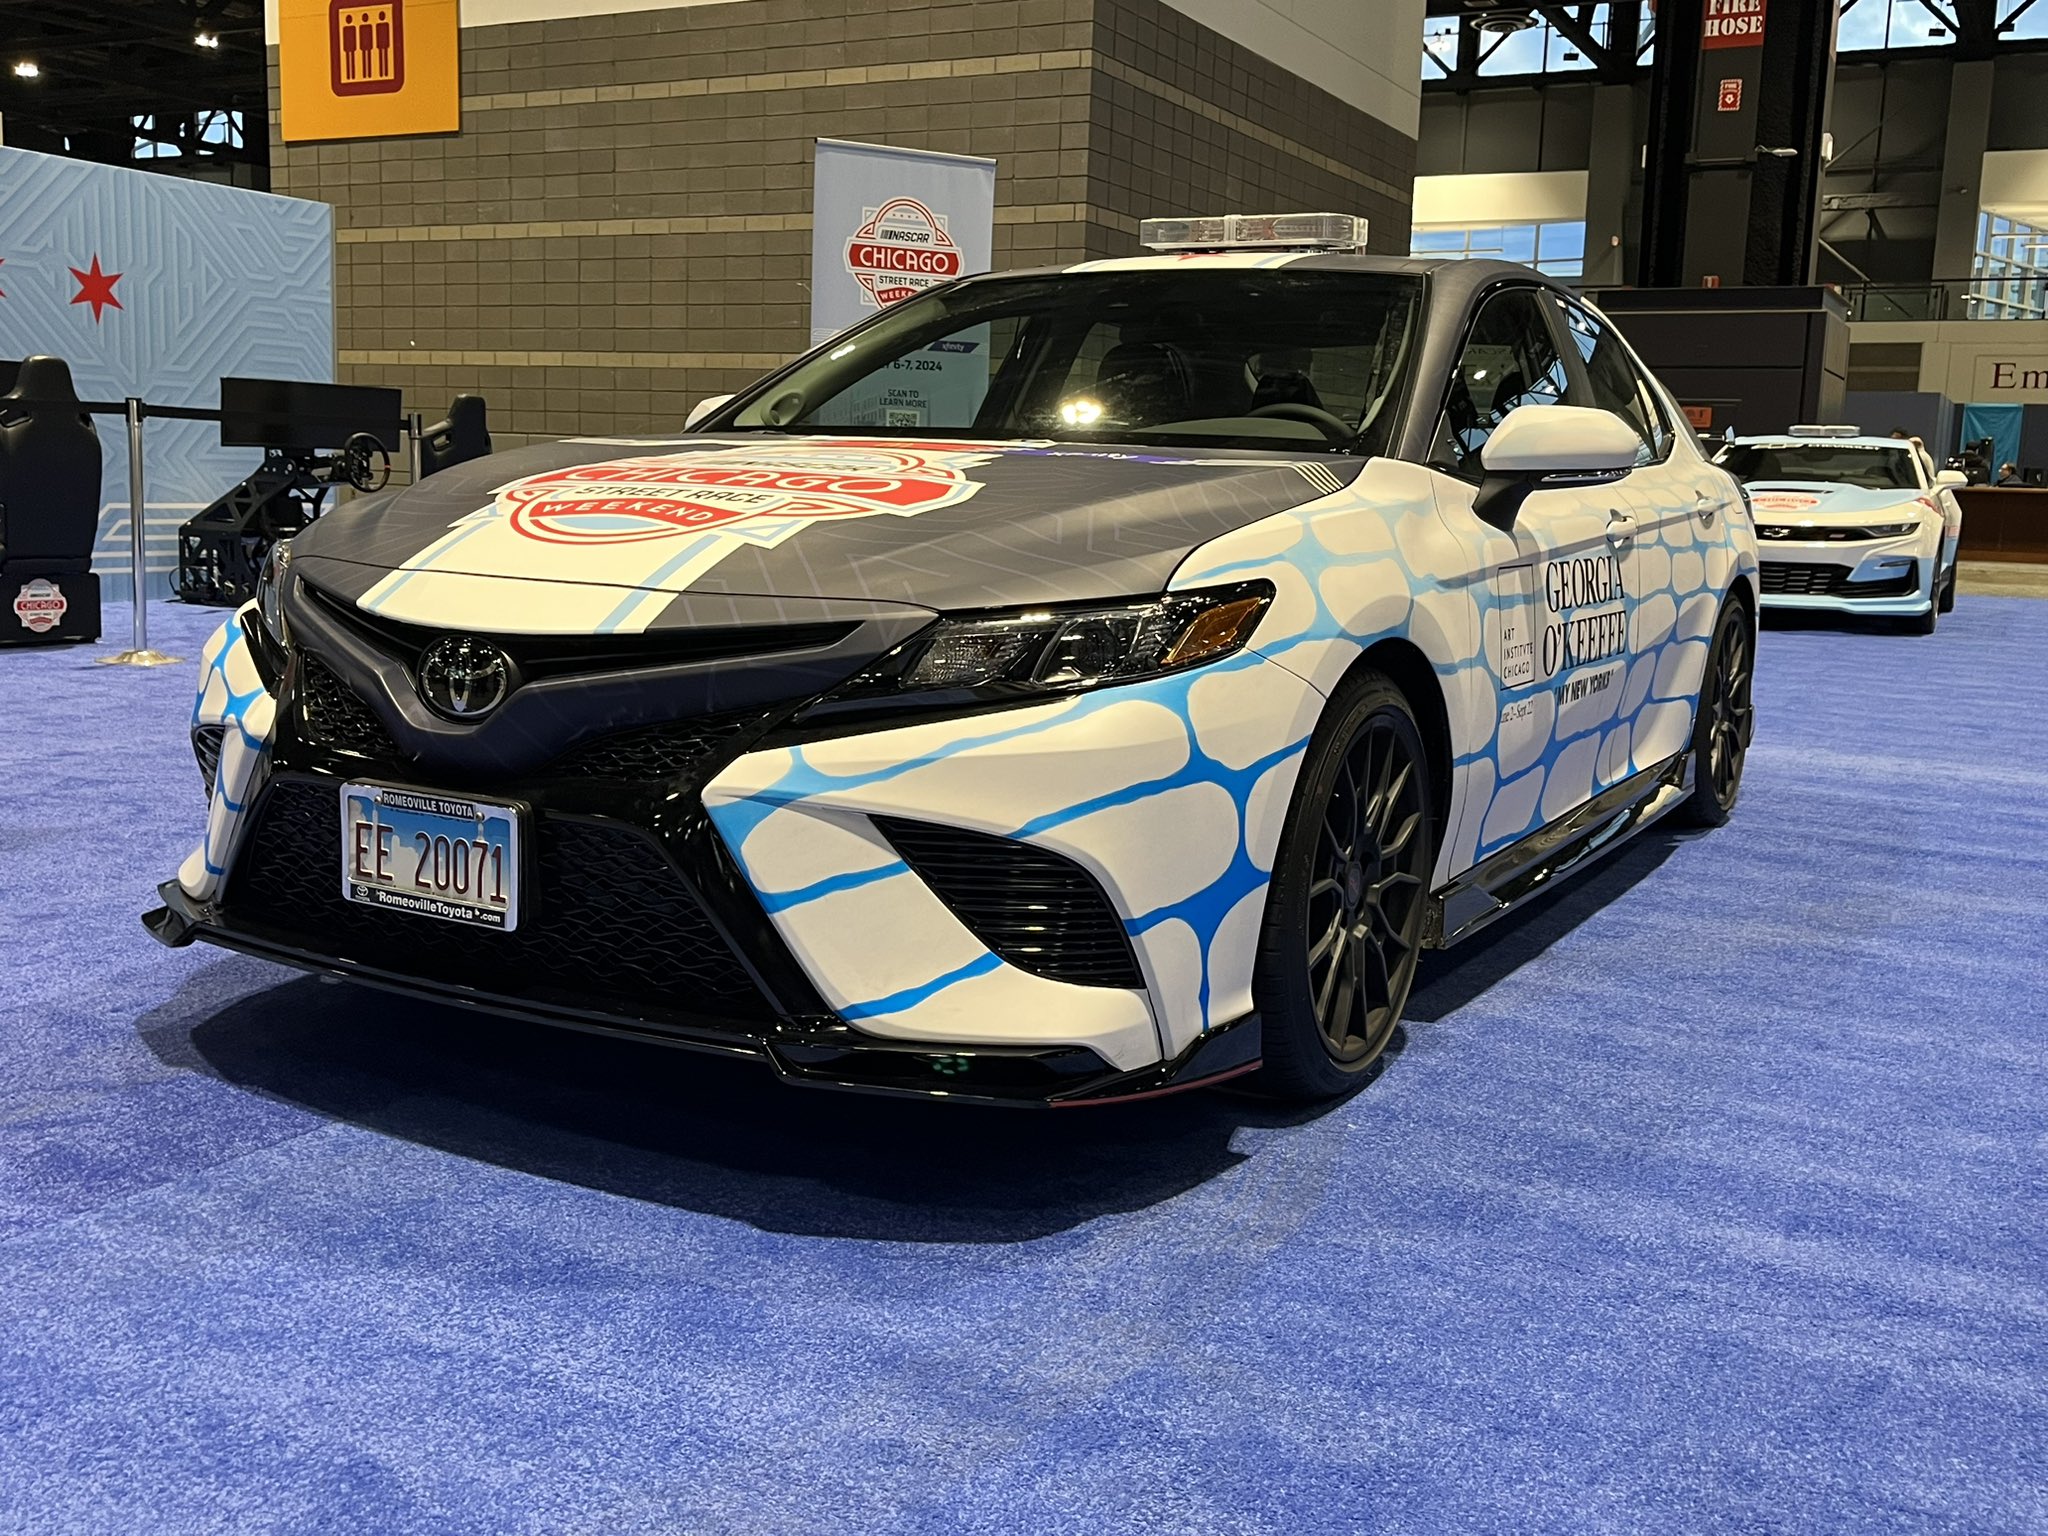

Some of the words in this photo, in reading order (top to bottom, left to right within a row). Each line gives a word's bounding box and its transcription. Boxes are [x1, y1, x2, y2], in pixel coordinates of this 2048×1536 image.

[1709, 0, 1761, 15] FIRE
[1704, 16, 1763, 37] HOSE
[887, 229, 930, 243] NASCAR
[860, 247, 949, 272] CHICAGO
[879, 275, 907, 286] STREET
[909, 278, 929, 287] RACE
[880, 290, 913, 300] WEEKE
[893, 360, 913, 371] 6-7,
[915, 360, 942, 371] 2024
[888, 389, 907, 398] SCAN
[909, 390, 919, 398] TO
[880, 398, 905, 407] LEARN
[906, 399, 927, 408] MORE
[564, 466, 902, 493] CHICAGO
[575, 486, 689, 499] STREET
[691, 490, 774, 504] RACE
[543, 500, 714, 522] WEEKEND
[1546, 556, 1625, 613] GEORGIA
[1504, 627, 1515, 641] ART
[1543, 611, 1627, 677] O'KEEFFE
[1503, 661, 1530, 679] CHICAGO
[1571, 678, 1588, 702] NEW
[383, 793, 437, 812] ROMEOVILLE
[439, 801, 474, 818] TOYOTA
[356, 821, 394, 881] EE
[415, 831, 507, 904] 20071
